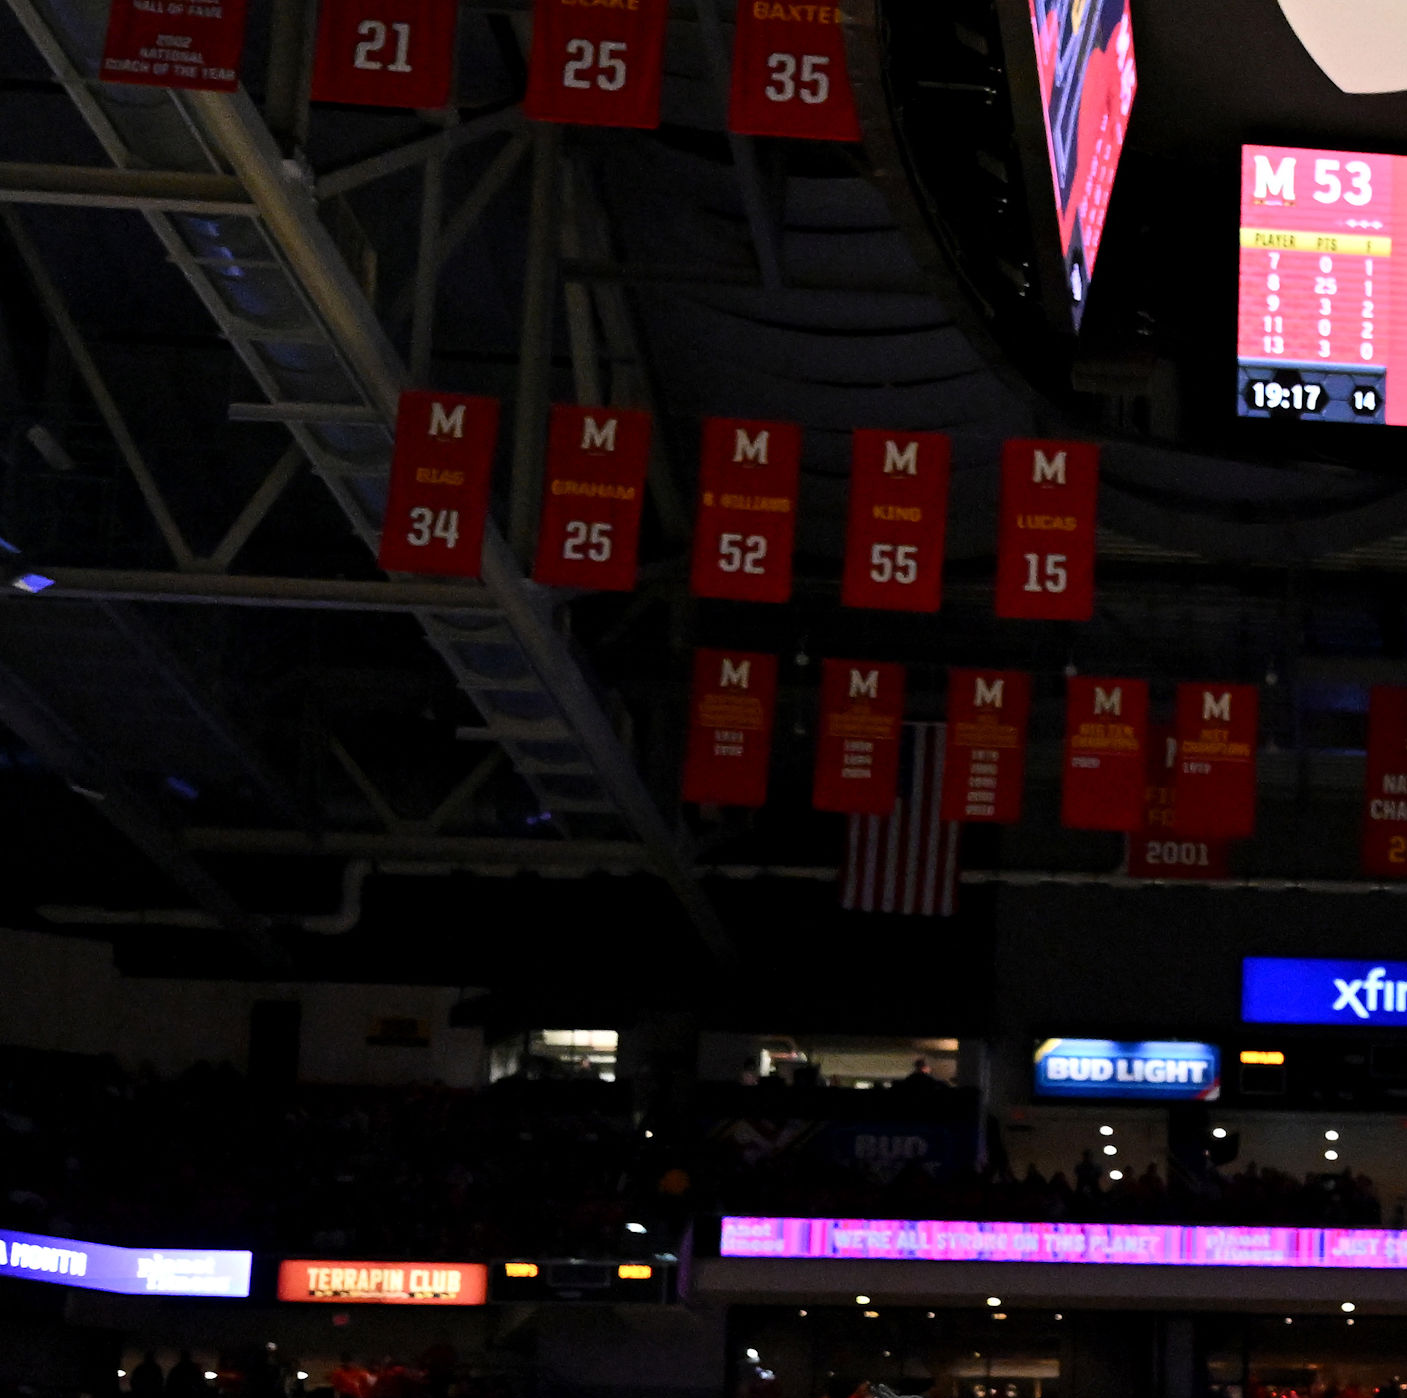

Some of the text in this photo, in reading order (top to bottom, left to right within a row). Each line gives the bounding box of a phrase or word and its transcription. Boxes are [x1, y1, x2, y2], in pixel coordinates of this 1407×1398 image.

[353, 18, 413, 73] 21
[562, 37, 629, 92] 25
[764, 52, 830, 105] 35
[1253, 155, 1373, 206] M 53
[1268, 252, 1374, 276] 7 0 1
[1267, 273, 1280, 291] 8
[1364, 280, 1373, 297] 1
[1266, 294, 1374, 318] 9 3 2
[1263, 315, 1374, 339] 11 0 2
[1263, 336, 1285, 354] 13
[1317, 339, 1331, 357] 3
[1252, 382, 1376, 410] 19:17 14
[428, 401, 467, 439] M
[579, 416, 619, 452] M
[731, 428, 771, 466] M
[882, 439, 920, 477] M
[1031, 448, 1068, 486] M
[406, 505, 460, 550] 34
[1016, 512, 1078, 532] LUCAS
[562, 520, 614, 563] 25
[717, 532, 769, 575] 52
[869, 542, 919, 585] 55
[1022, 552, 1068, 594] 15
[719, 657, 751, 689] M
[849, 667, 880, 699] M
[973, 676, 1005, 709] M
[1093, 685, 1123, 717] M
[1202, 691, 1232, 722] M
[1046, 1056, 1208, 1084] BUD LIGHT
[897, 1230, 932, 1250] ALL
[1043, 1234, 1085, 1254] THIS
[1332, 1236, 1381, 1258] JUST
[11, 1242, 88, 1277] MONTH
[307, 1266, 463, 1293] TERRAPIN CLUB
